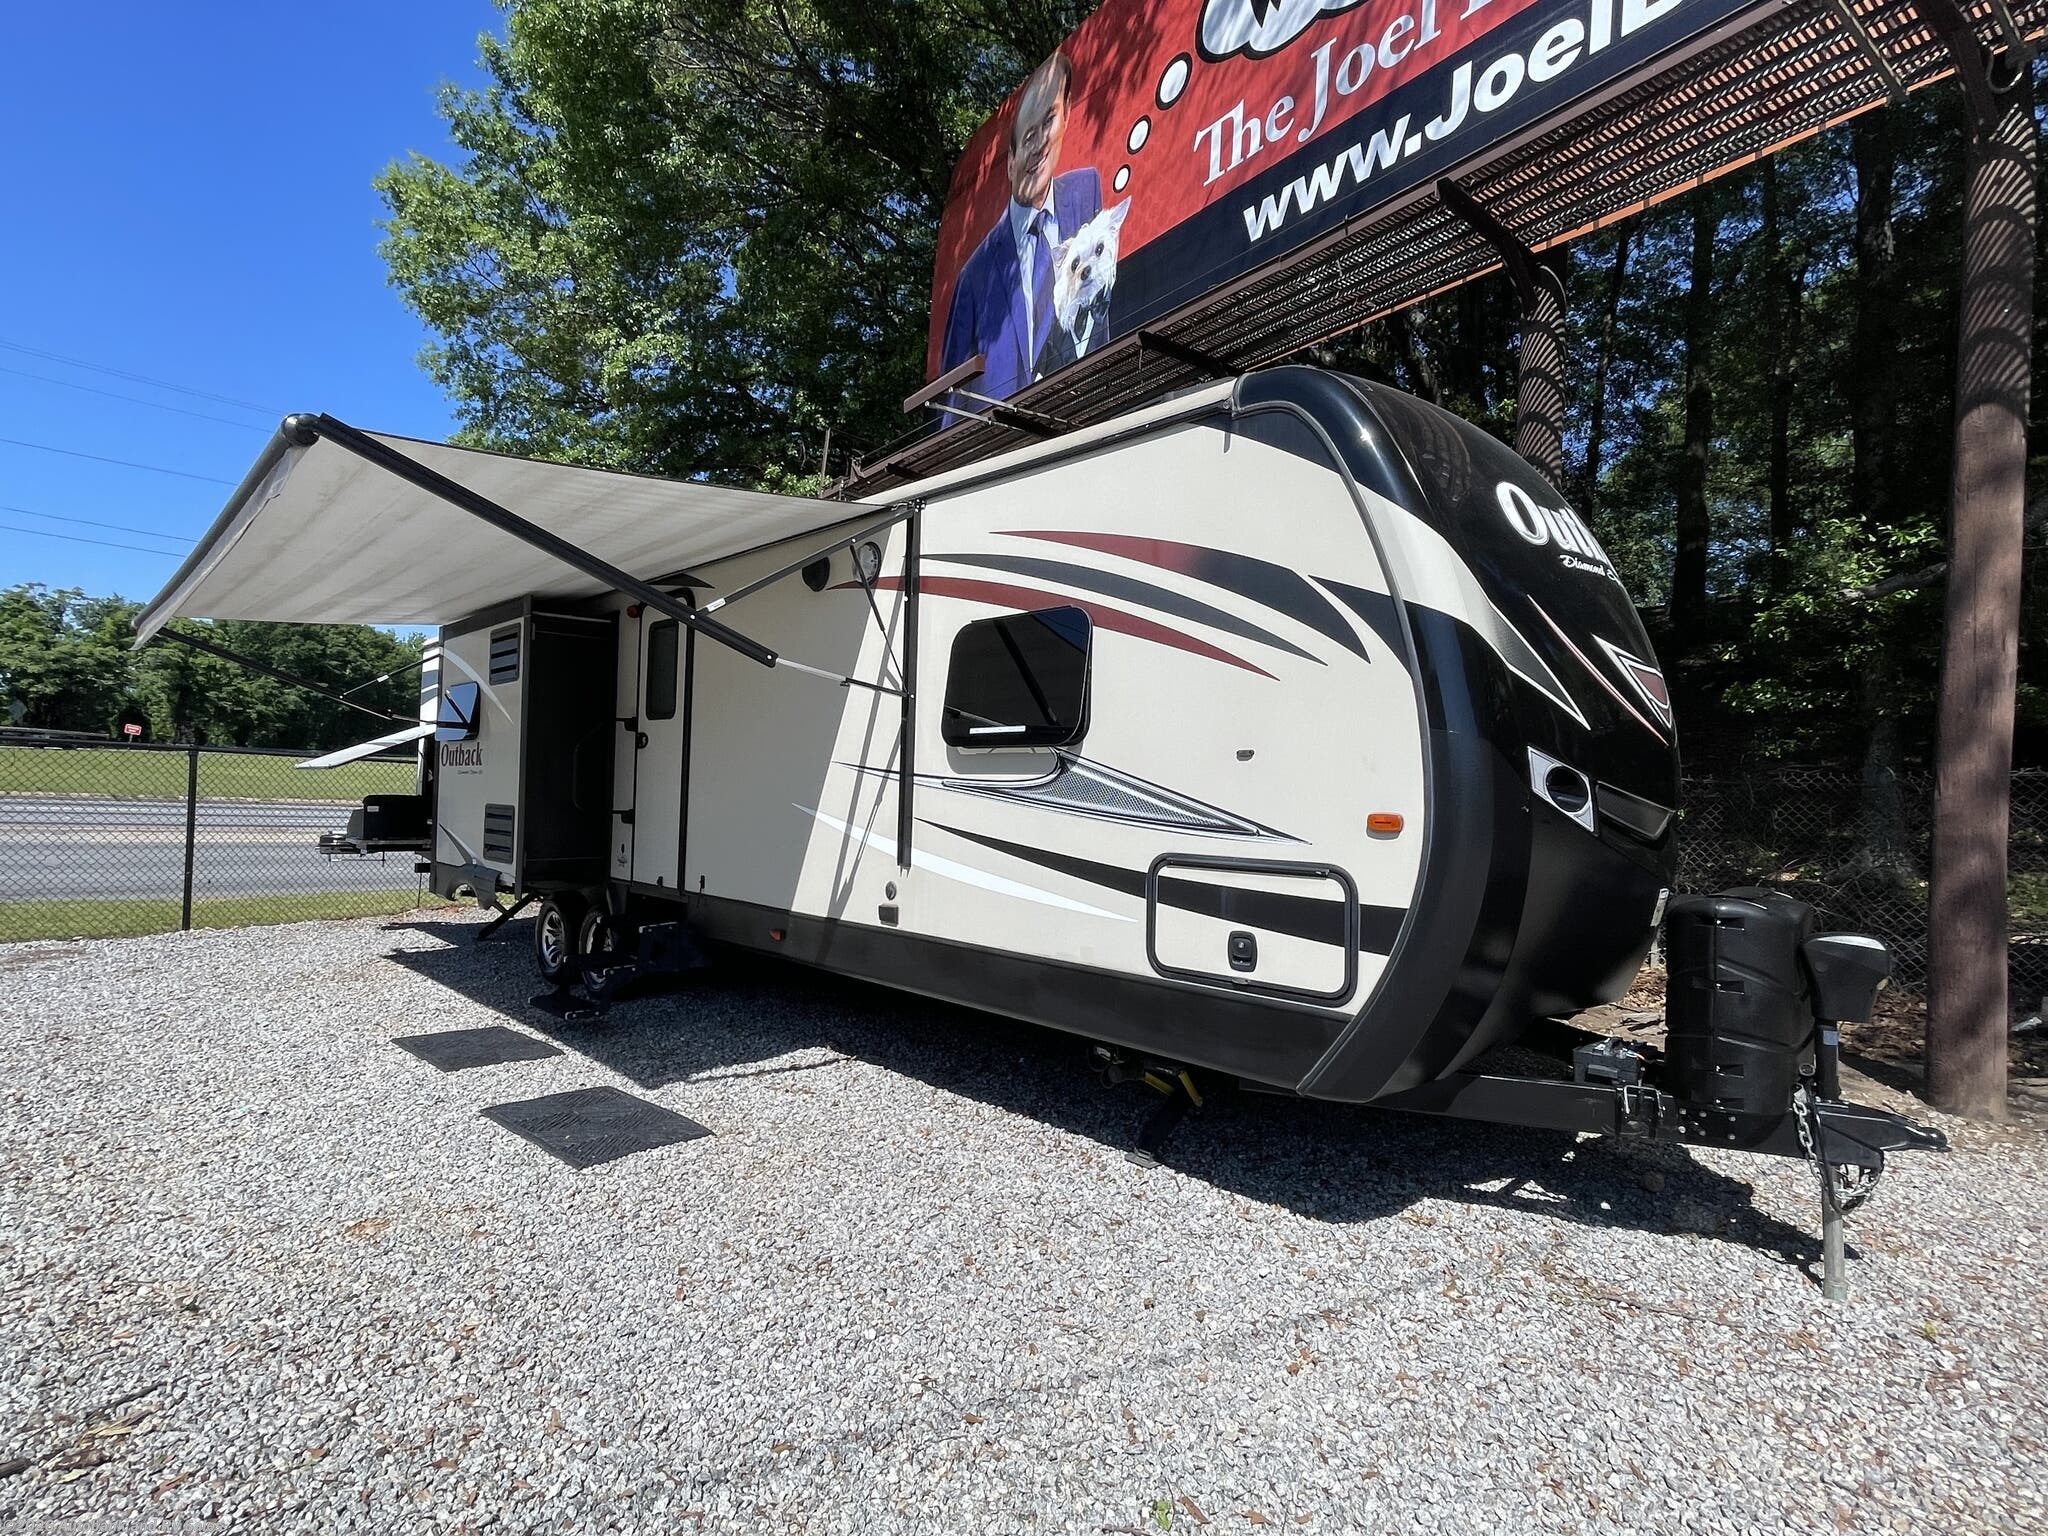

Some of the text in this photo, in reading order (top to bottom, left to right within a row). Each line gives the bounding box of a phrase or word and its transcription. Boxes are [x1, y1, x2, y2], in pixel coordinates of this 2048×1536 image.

[1193, 0, 1442, 186] The Joel
[441, 742, 483, 767] Outback
